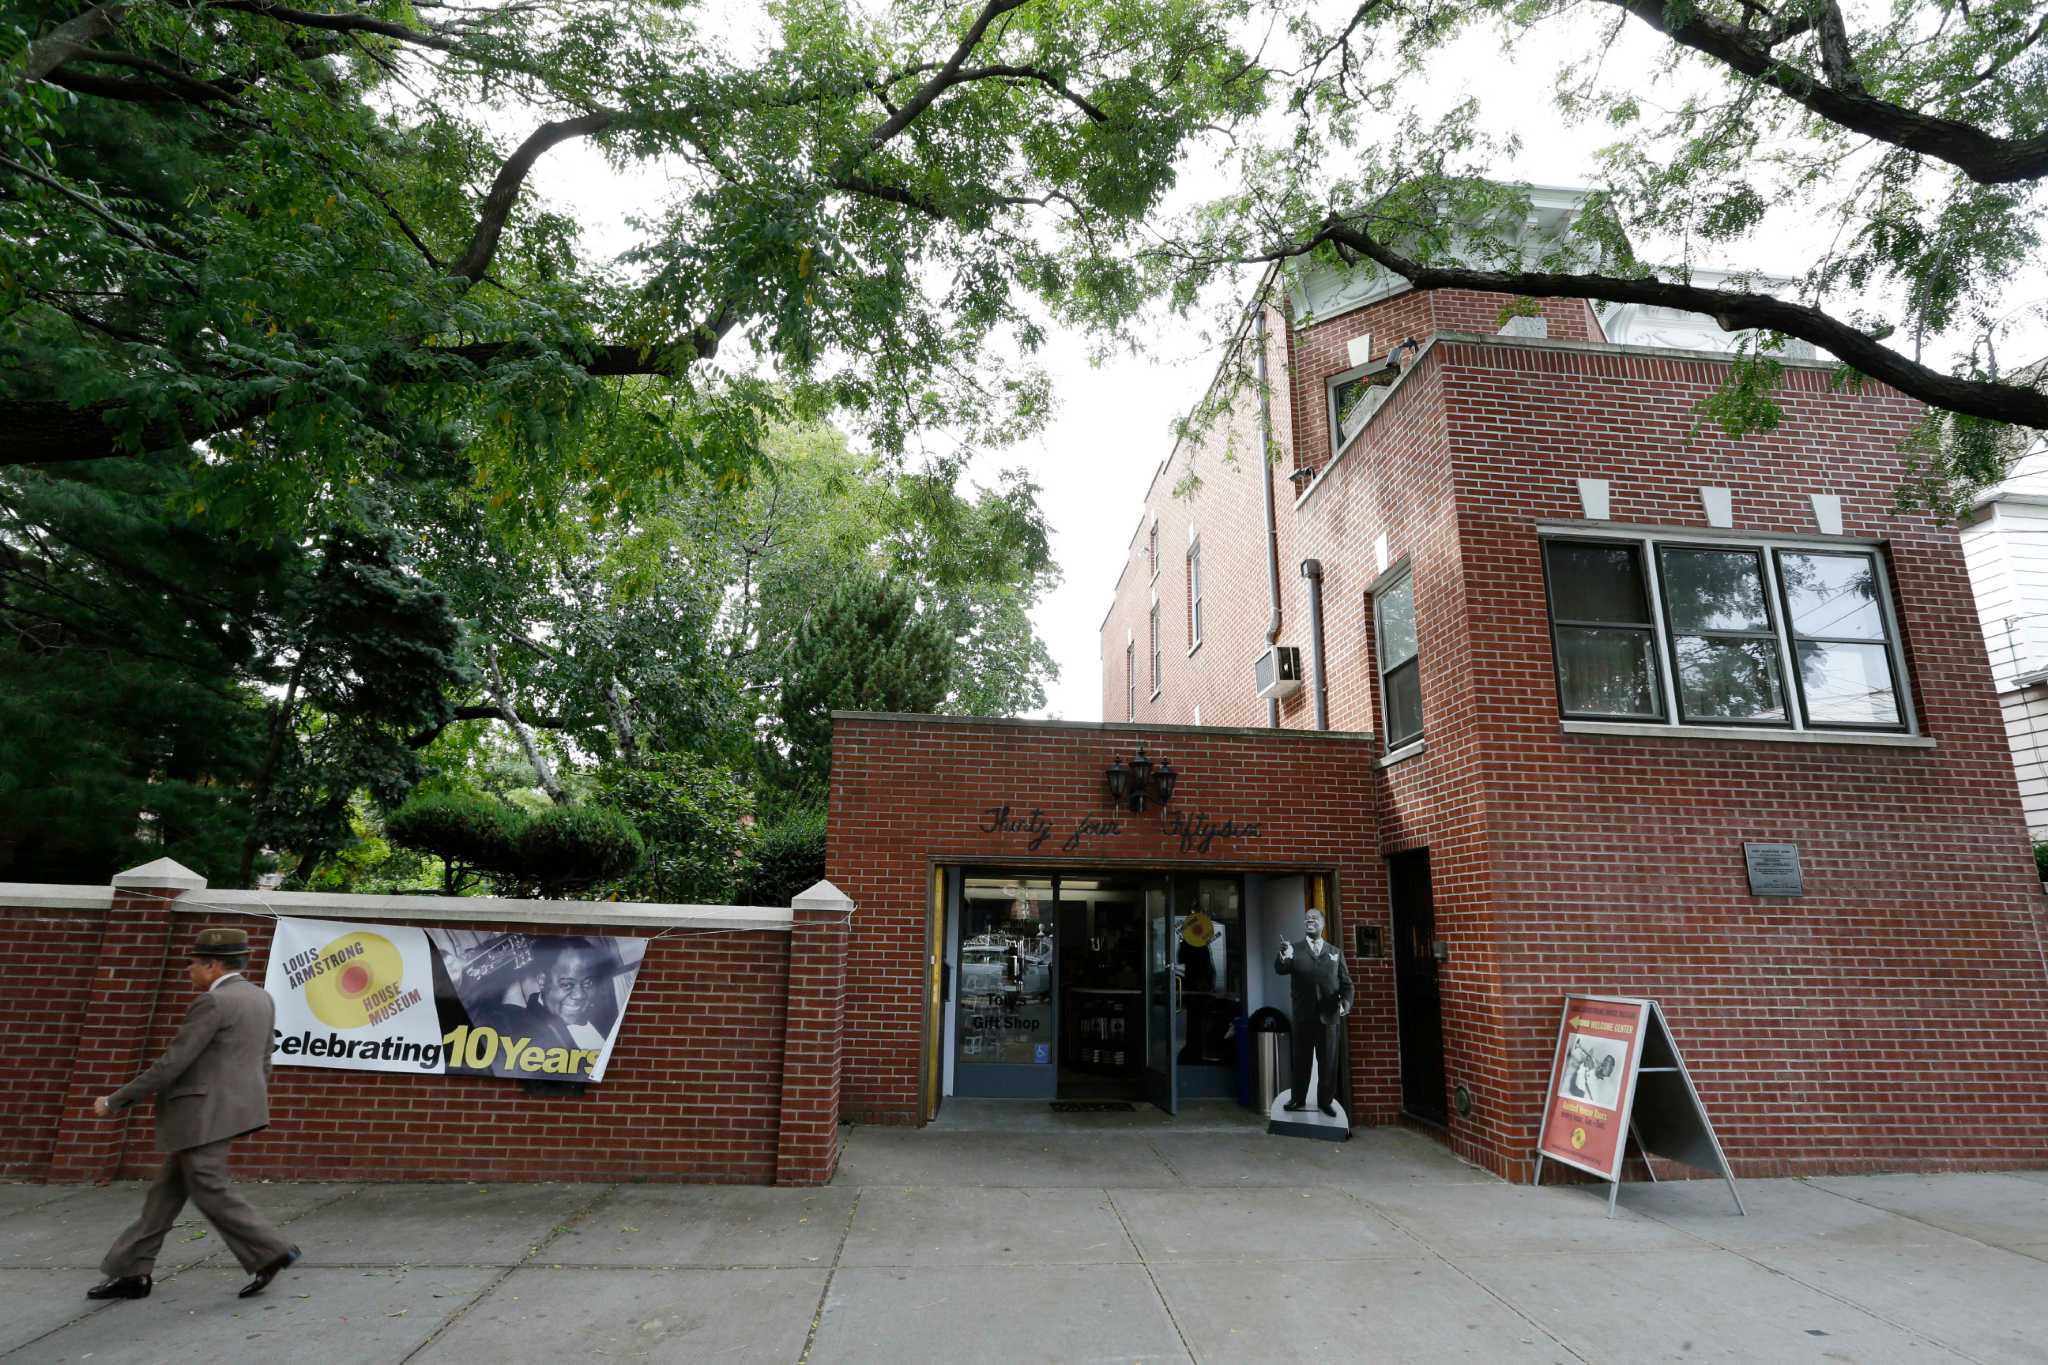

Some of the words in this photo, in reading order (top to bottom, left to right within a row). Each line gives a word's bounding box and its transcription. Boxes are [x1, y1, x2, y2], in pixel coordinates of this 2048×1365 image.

[282, 947, 320, 975] LOUIS
[289, 941, 365, 990] ARMSTRONG
[362, 981, 402, 1012] HOUSE
[368, 989, 423, 1027] MUSEUM
[975, 1016, 1000, 1029] Gift
[1004, 1016, 1040, 1032] Shop
[442, 1024, 499, 1069] 10
